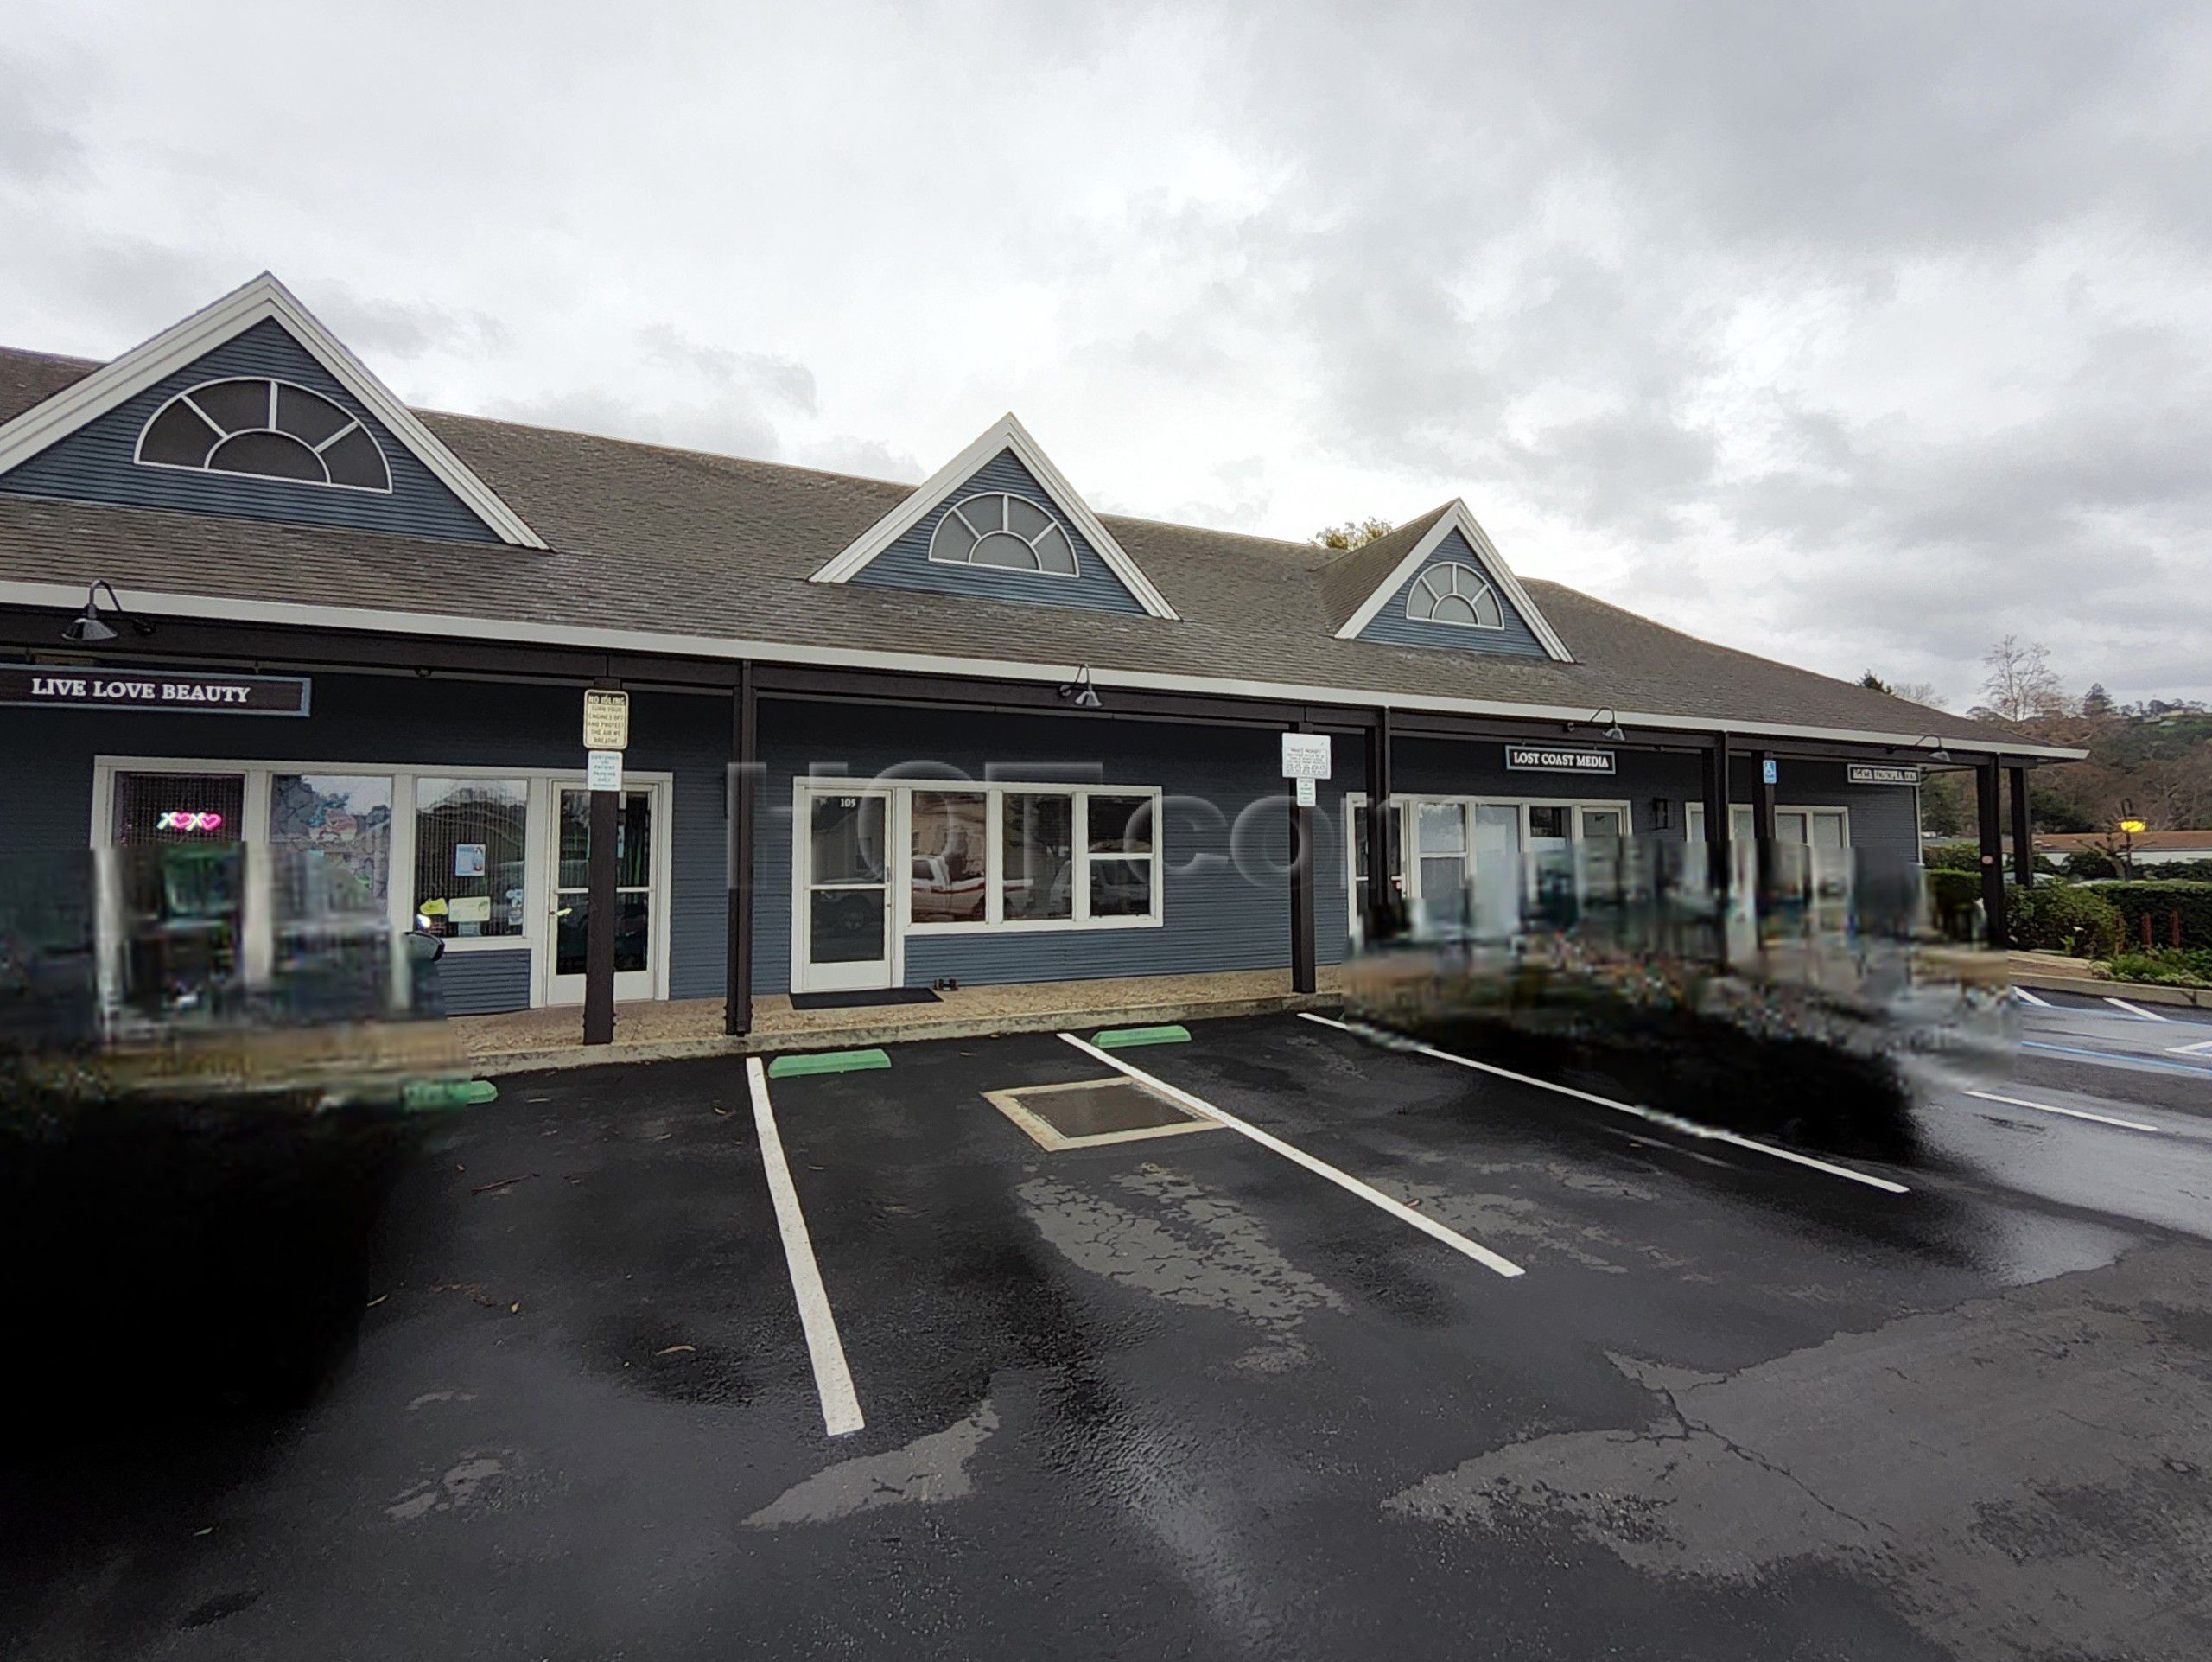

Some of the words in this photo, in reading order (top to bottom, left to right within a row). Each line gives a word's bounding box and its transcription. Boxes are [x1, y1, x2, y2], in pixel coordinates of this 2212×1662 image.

[32, 678, 86, 697] LIVE
[92, 680, 156, 699] LOVE
[162, 685, 251, 703] BEAUTY
[588, 695, 600, 704] NO
[1514, 751, 1540, 765] LOST
[1541, 753, 1574, 766] COAST
[1576, 755, 1609, 767] MEDIA
[841, 798, 856, 807] 105
